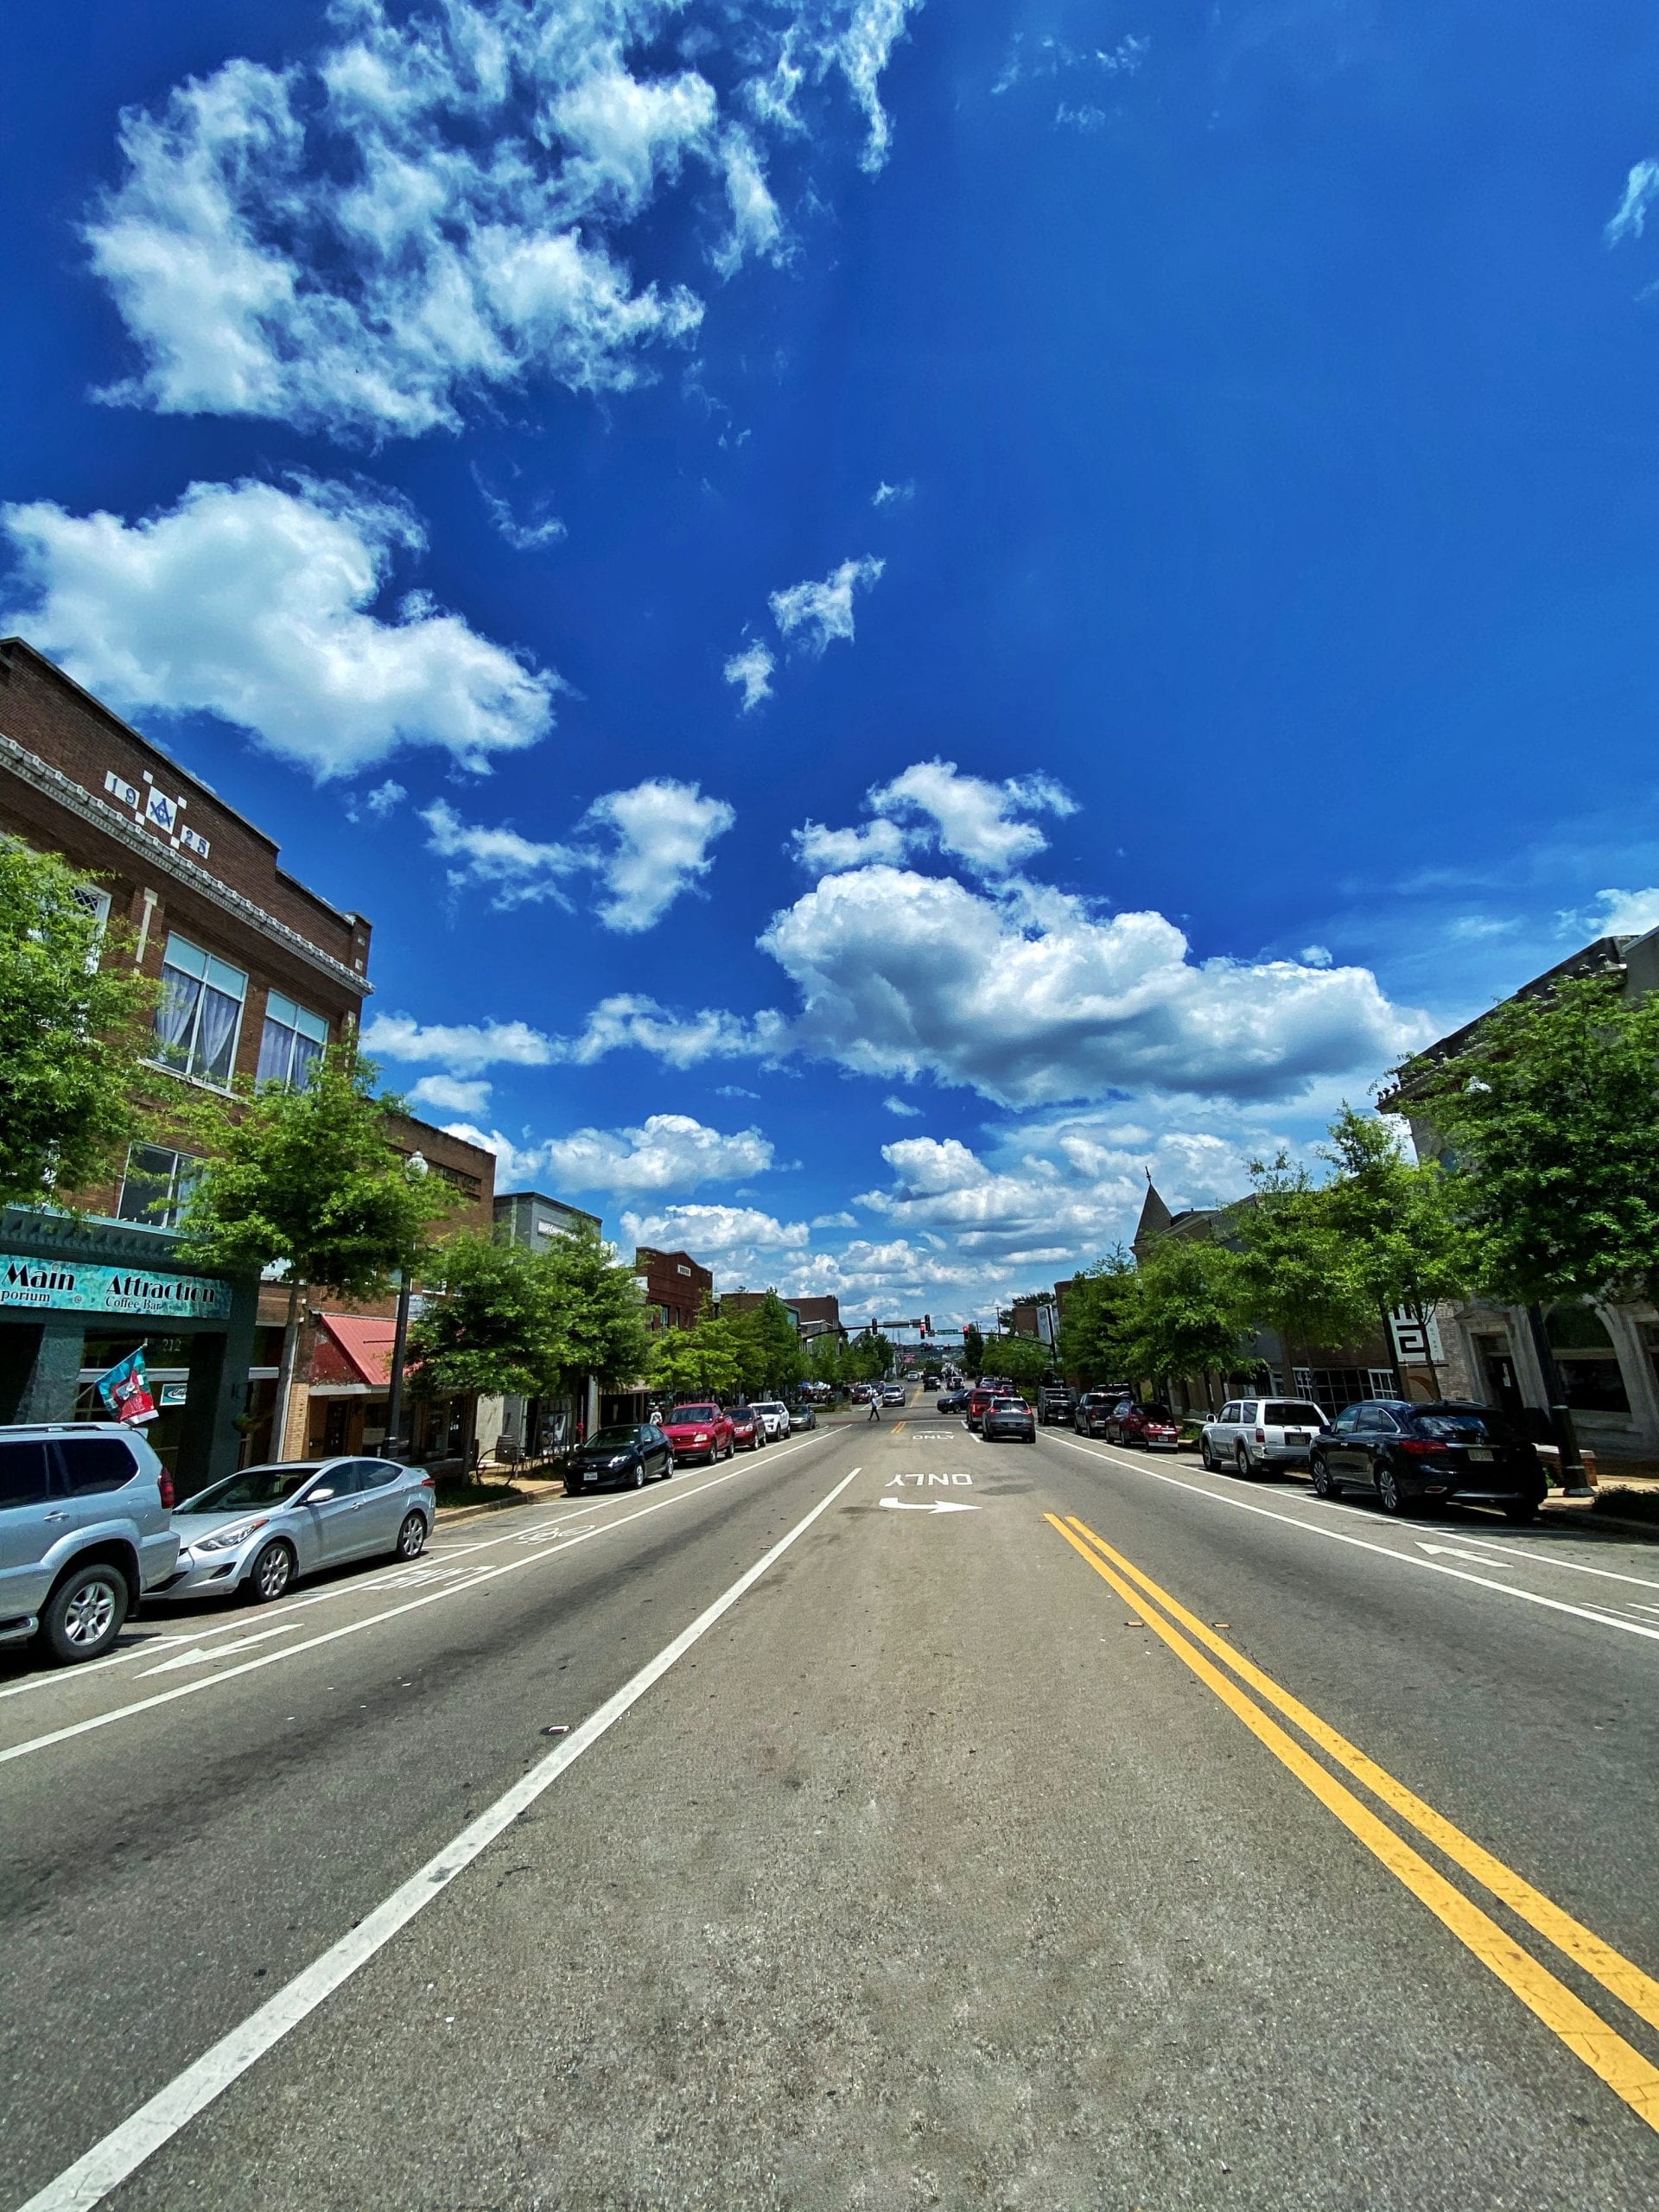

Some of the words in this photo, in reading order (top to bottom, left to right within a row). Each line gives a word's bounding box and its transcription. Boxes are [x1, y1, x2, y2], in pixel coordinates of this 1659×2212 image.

[111, 778, 137, 805] 19
[184, 830, 207, 855] 25
[2, 1262, 75, 1291] Main
[106, 1274, 215, 1303] Attraction
[106, 1296, 140, 1309] Coffee
[143, 1299, 162, 1310] Bar
[884, 1473, 974, 1487] ONLY
